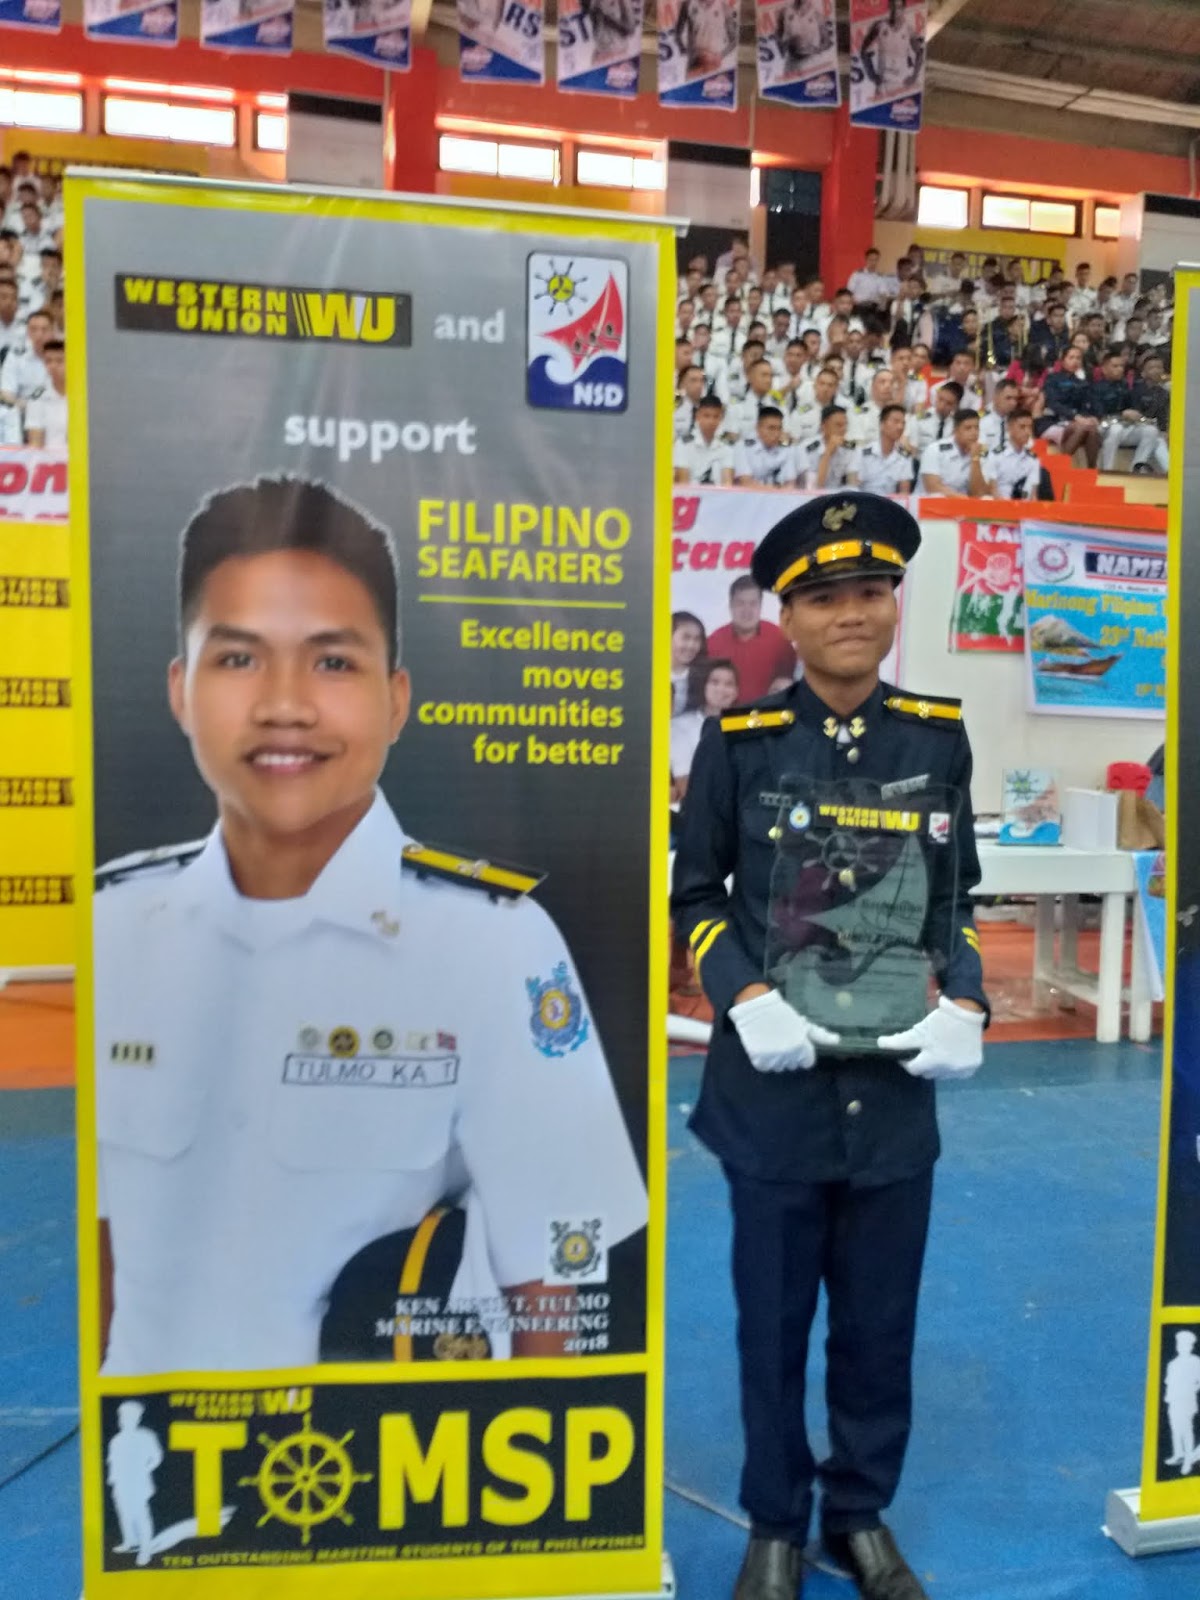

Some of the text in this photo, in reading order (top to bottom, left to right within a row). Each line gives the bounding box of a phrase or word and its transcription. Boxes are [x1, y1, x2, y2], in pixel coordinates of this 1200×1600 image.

[124, 278, 287, 313] WESTERN
[176, 306, 287, 335] UNION
[303, 293, 396, 342] WU
[434, 309, 506, 343] and
[573, 382, 623, 408] NSD
[284, 414, 478, 463] support
[418, 499, 632, 550] FILIPINO
[417, 545, 624, 585] SEAFARERS
[1097, 553, 1167, 579] NAME
[460, 618, 625, 653] Excellence
[522, 665, 625, 690] moves
[417, 699, 624, 728] communities
[472, 733, 624, 765] for better
[296, 1061, 376, 1082] TULMO
[395, 1297, 441, 1316] KEN
[535, 1293, 611, 1312] TULMO
[375, 1317, 463, 1337] MARINE
[563, 1334, 609, 1352] 2018
[162, 1555, 193, 1568] TEN
[196, 1550, 313, 1566] OUTSTANDING
[316, 1546, 398, 1562] MARITIME
[401, 1543, 483, 1559] STUDENTS
[510, 1539, 541, 1553] THE
[543, 1535, 645, 1552] PHILIPPINES
